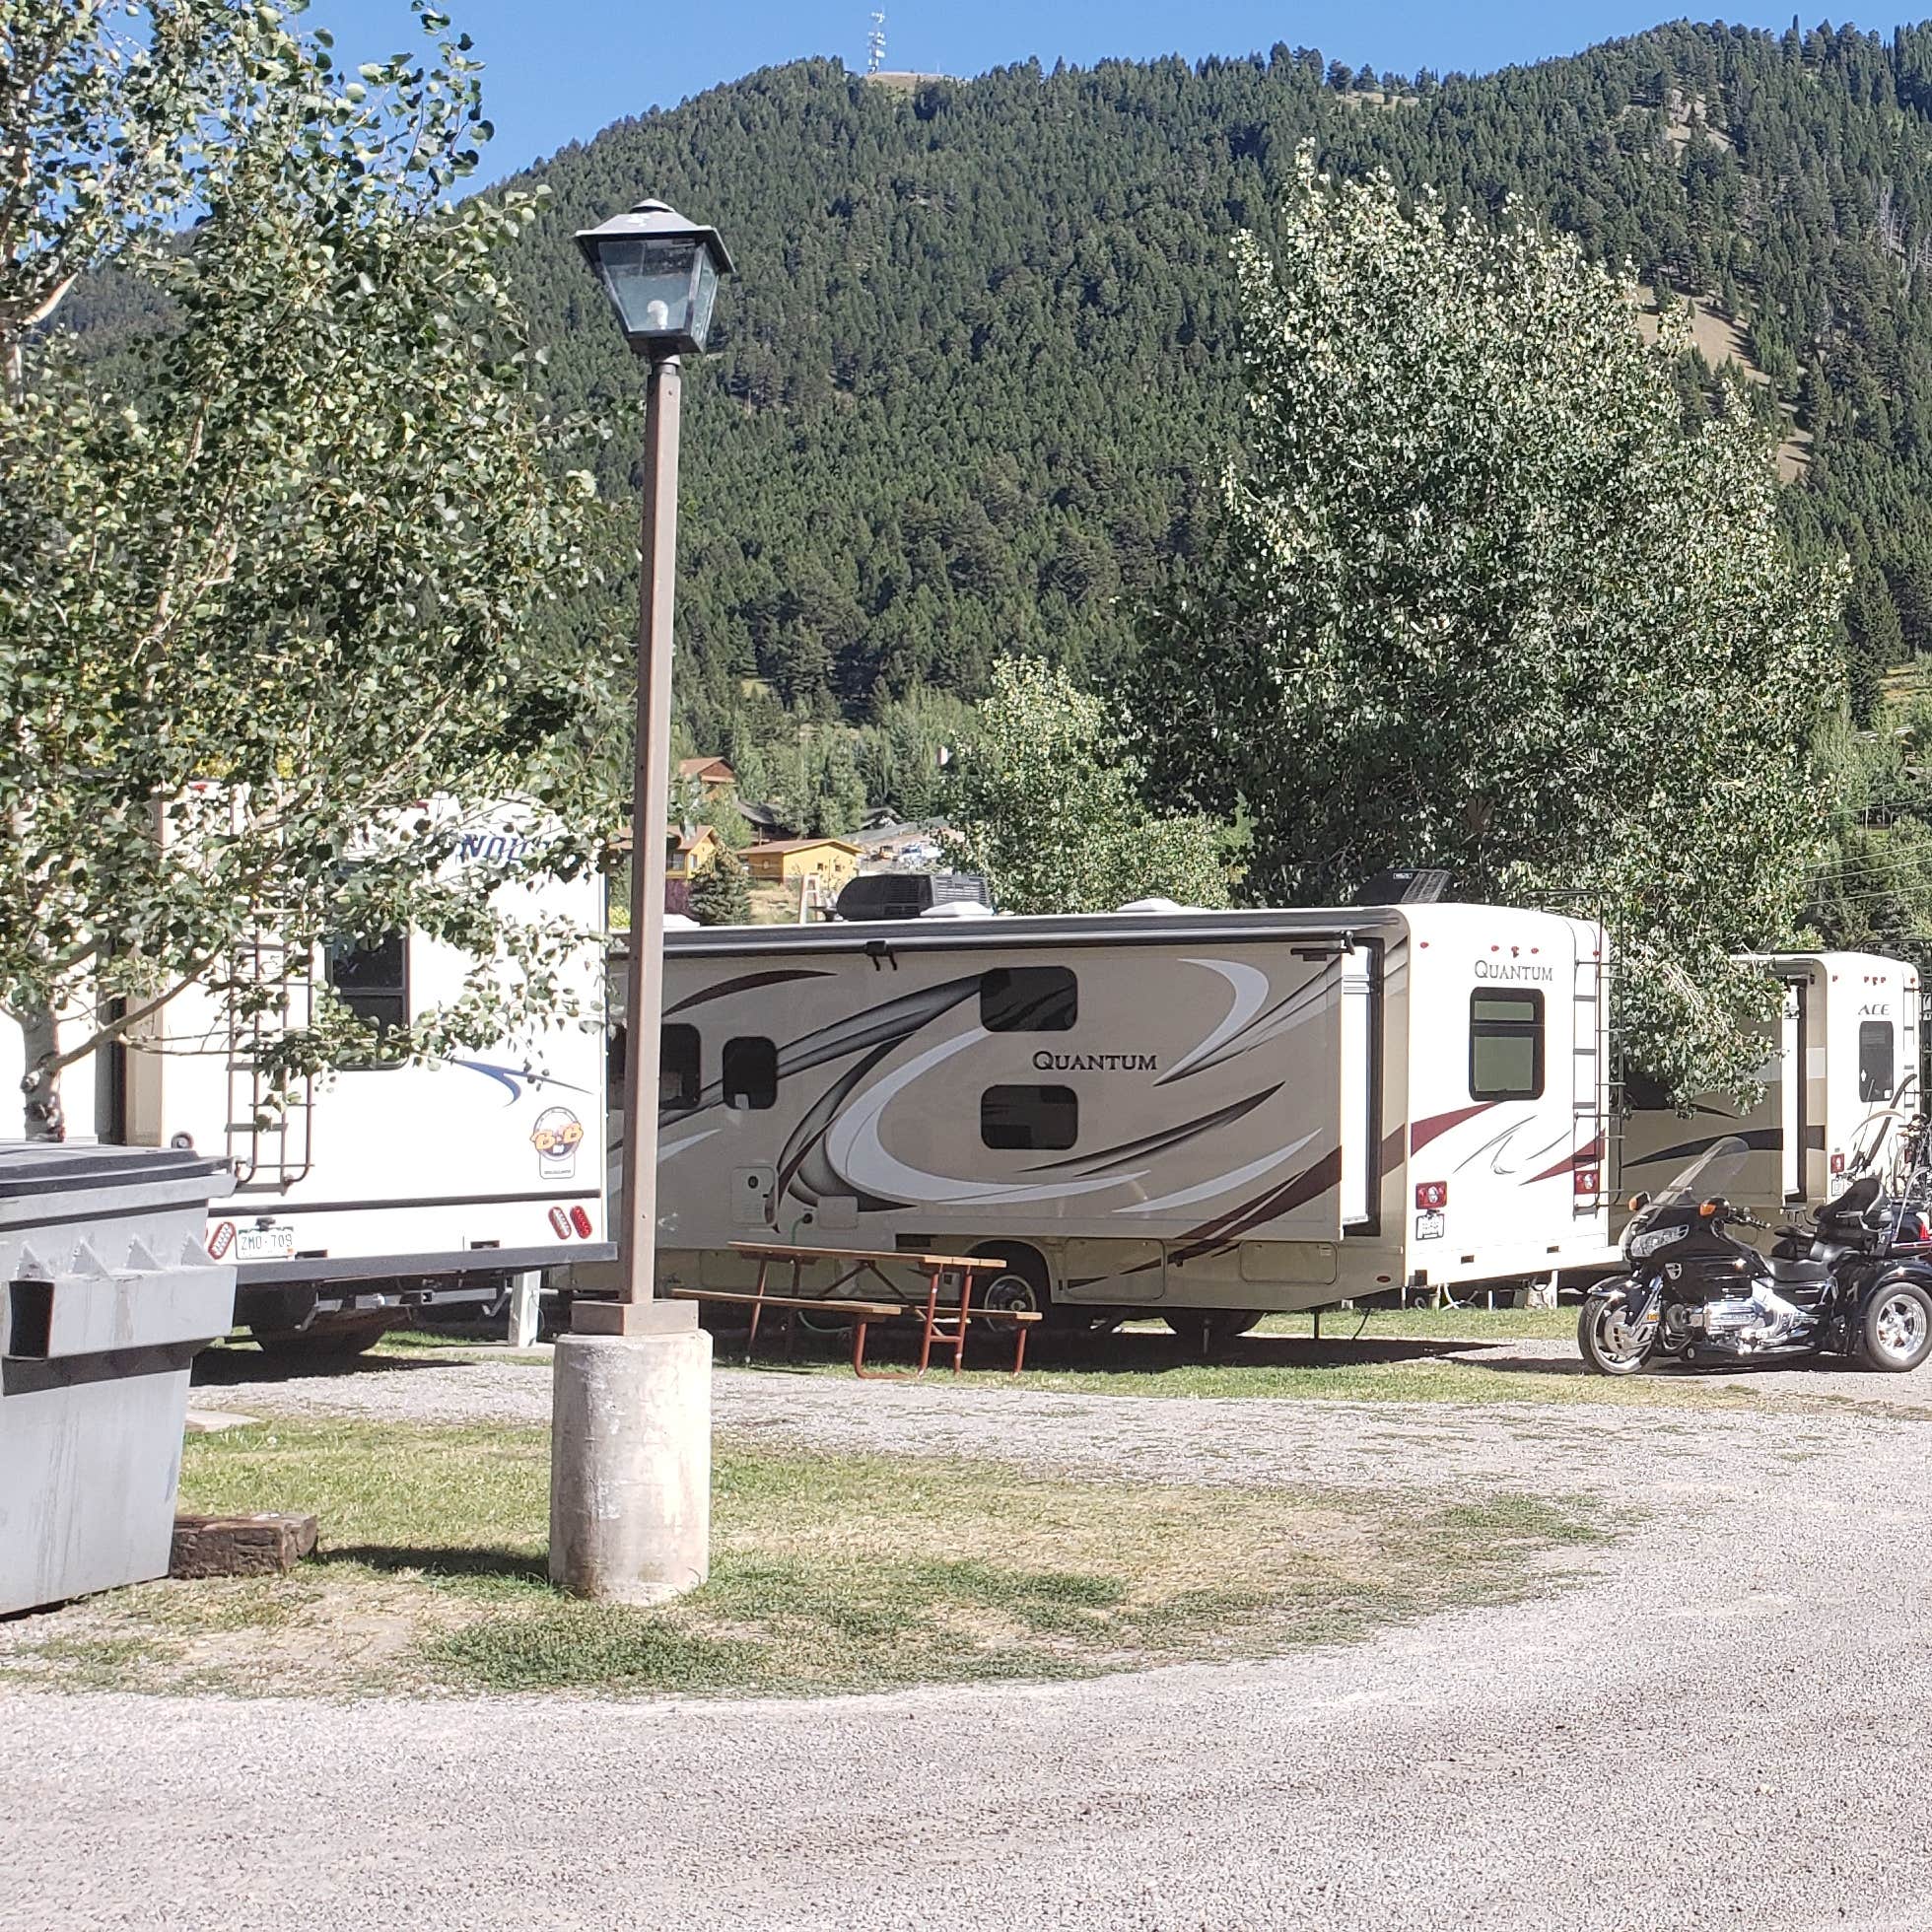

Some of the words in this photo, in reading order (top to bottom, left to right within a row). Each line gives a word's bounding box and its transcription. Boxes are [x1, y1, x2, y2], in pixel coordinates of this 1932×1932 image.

[1475, 959, 1553, 982] QUANTUM
[1858, 1003, 1891, 1015] ACE
[1033, 1051, 1157, 1070] QUANTUM
